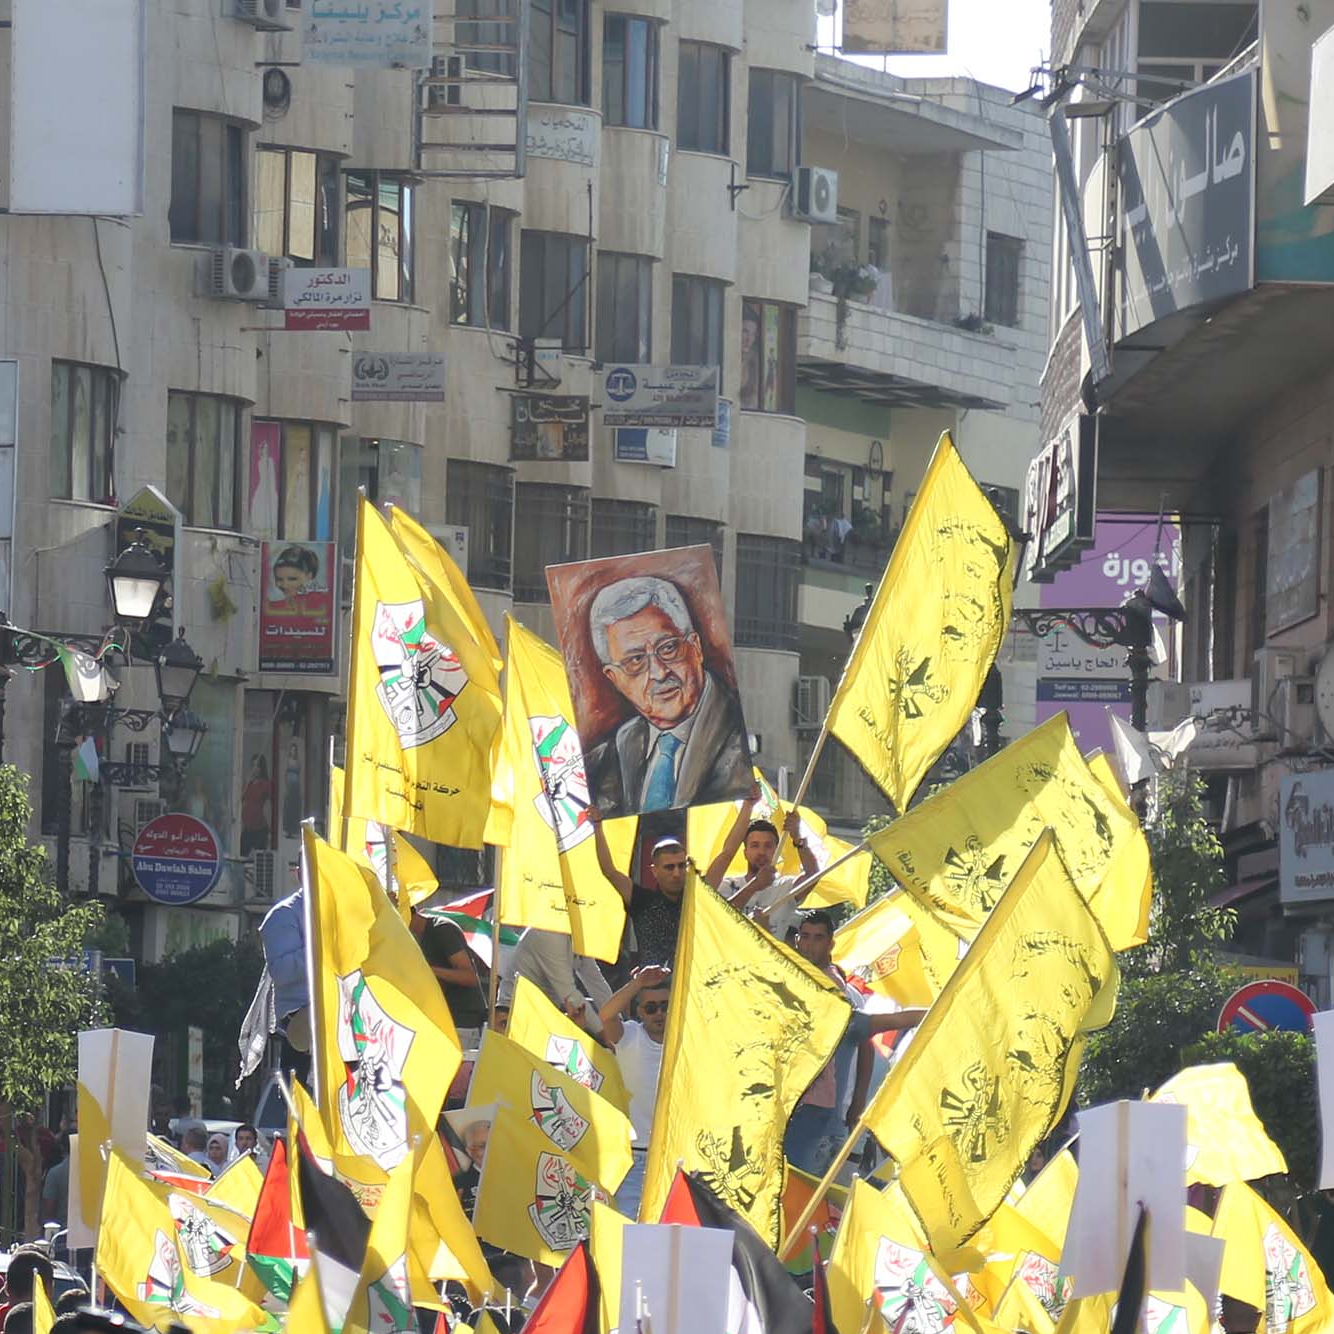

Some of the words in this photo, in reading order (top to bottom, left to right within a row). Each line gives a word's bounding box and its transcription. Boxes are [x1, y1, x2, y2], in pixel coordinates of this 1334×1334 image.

[307, 273, 351, 288] الدكتور
[1045, 657, 1081, 671] ياسين
[1085, 657, 1118, 672] الحاج
[136, 861, 154, 871] Abu
[188, 865, 213, 876] Salon
